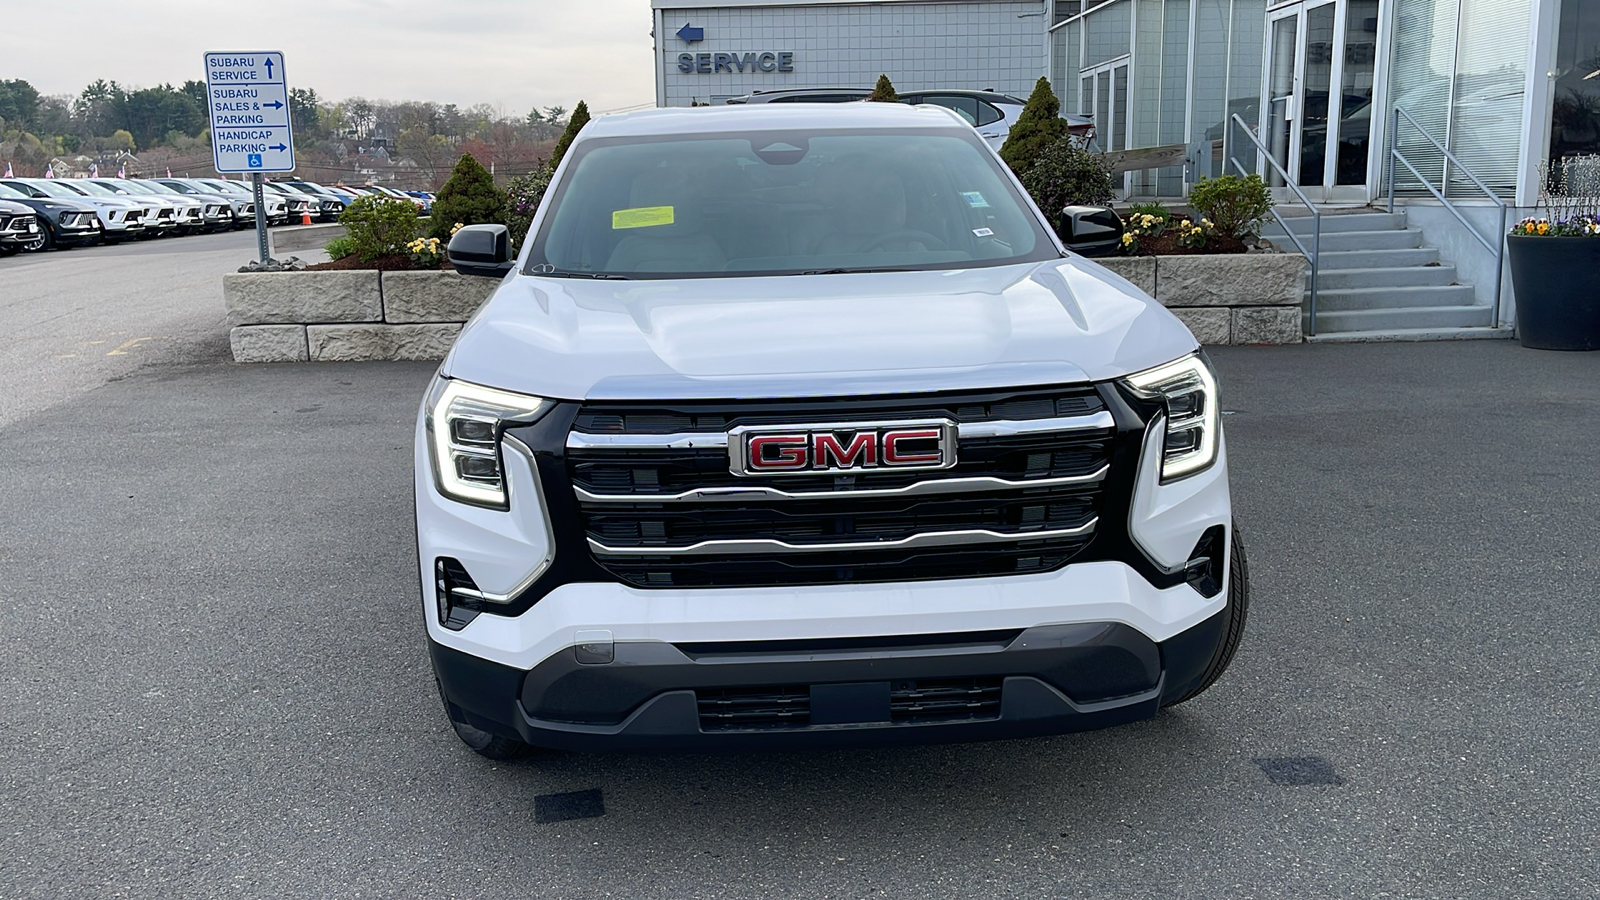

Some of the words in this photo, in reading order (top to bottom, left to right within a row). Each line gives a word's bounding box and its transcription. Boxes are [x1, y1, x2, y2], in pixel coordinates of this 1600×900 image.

[210, 58, 255, 67] SUBARU
[678, 52, 794, 74] SERVICE
[212, 71, 257, 80] SERVICE
[213, 89, 258, 99] SUBARU
[215, 102, 250, 111] SALES
[252, 102, 260, 111] &
[216, 115, 264, 124] PARKING
[218, 131, 272, 140] HANDICAP
[219, 144, 267, 153] PARKING
[749, 428, 943, 470] GMC
